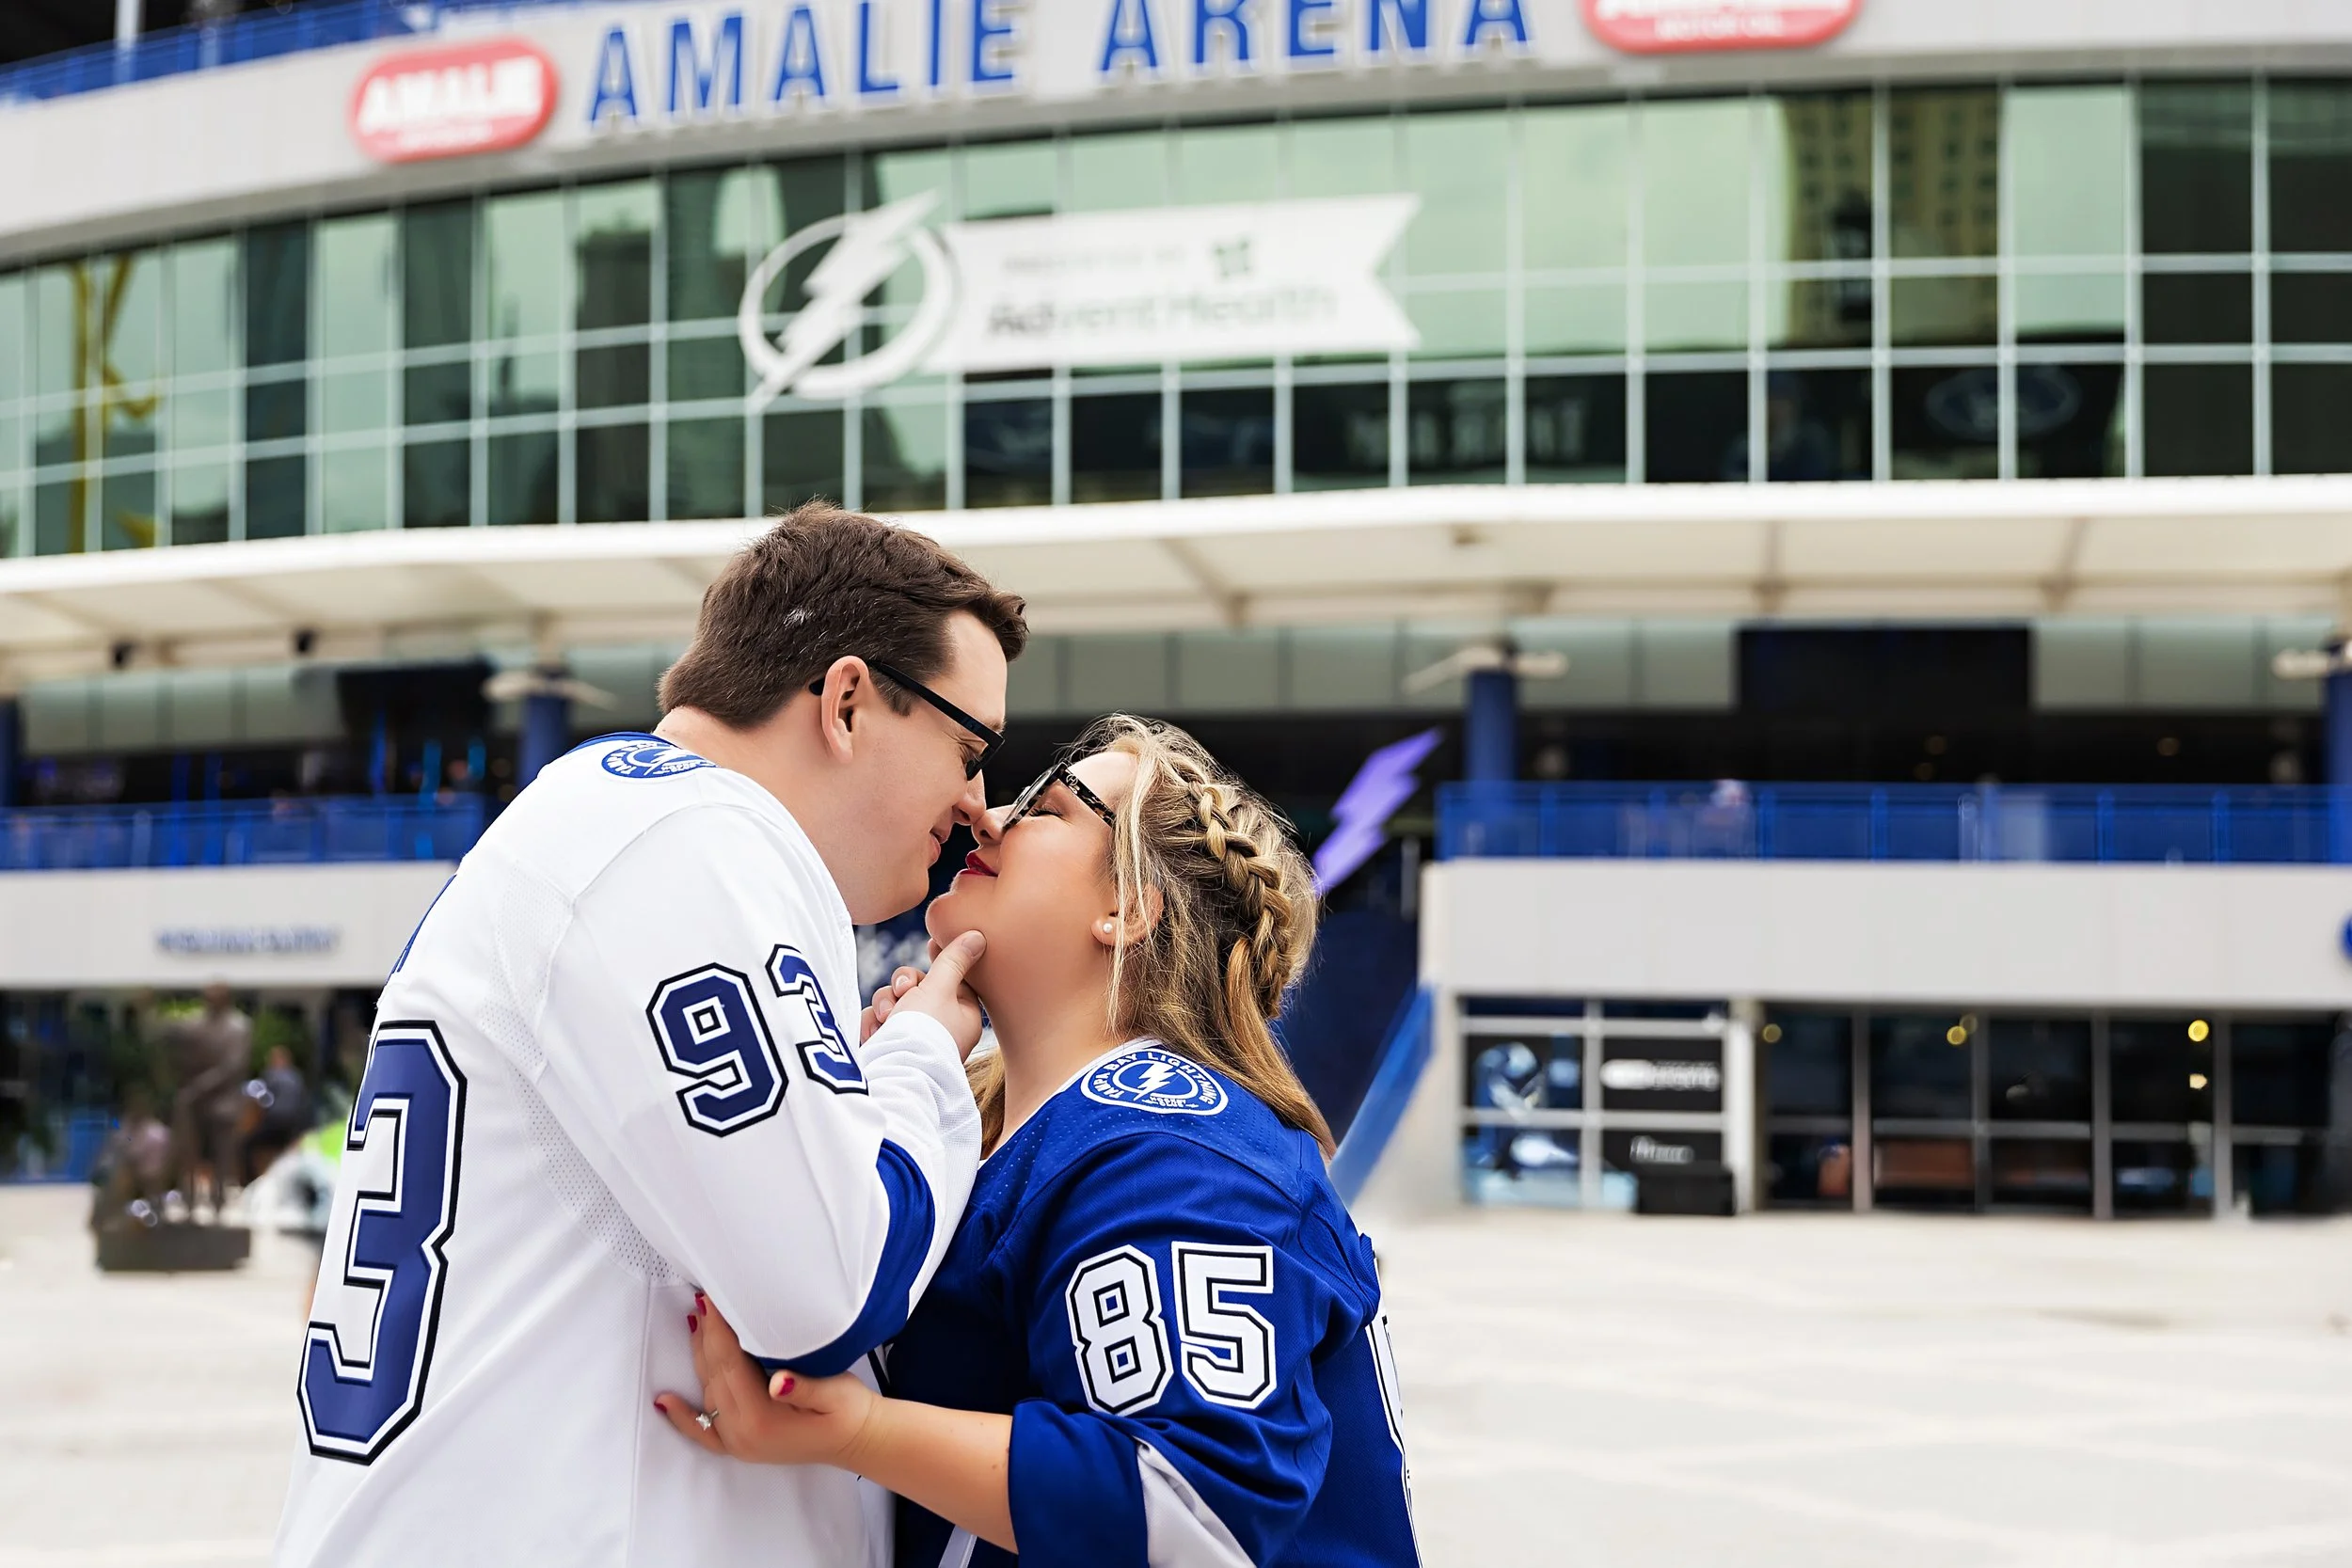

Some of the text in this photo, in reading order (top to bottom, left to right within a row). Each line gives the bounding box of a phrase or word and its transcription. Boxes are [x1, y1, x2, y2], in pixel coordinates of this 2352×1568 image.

[587, 0, 1528, 126] AMALIE ARENA
[646, 943, 868, 1137] 93
[1104, 1053, 1137, 1071] BAY
[1147, 1052, 1216, 1105] LIGHTNING
[1093, 1072, 1125, 1100] TAMPA
[1065, 1241, 1277, 1417] 85
